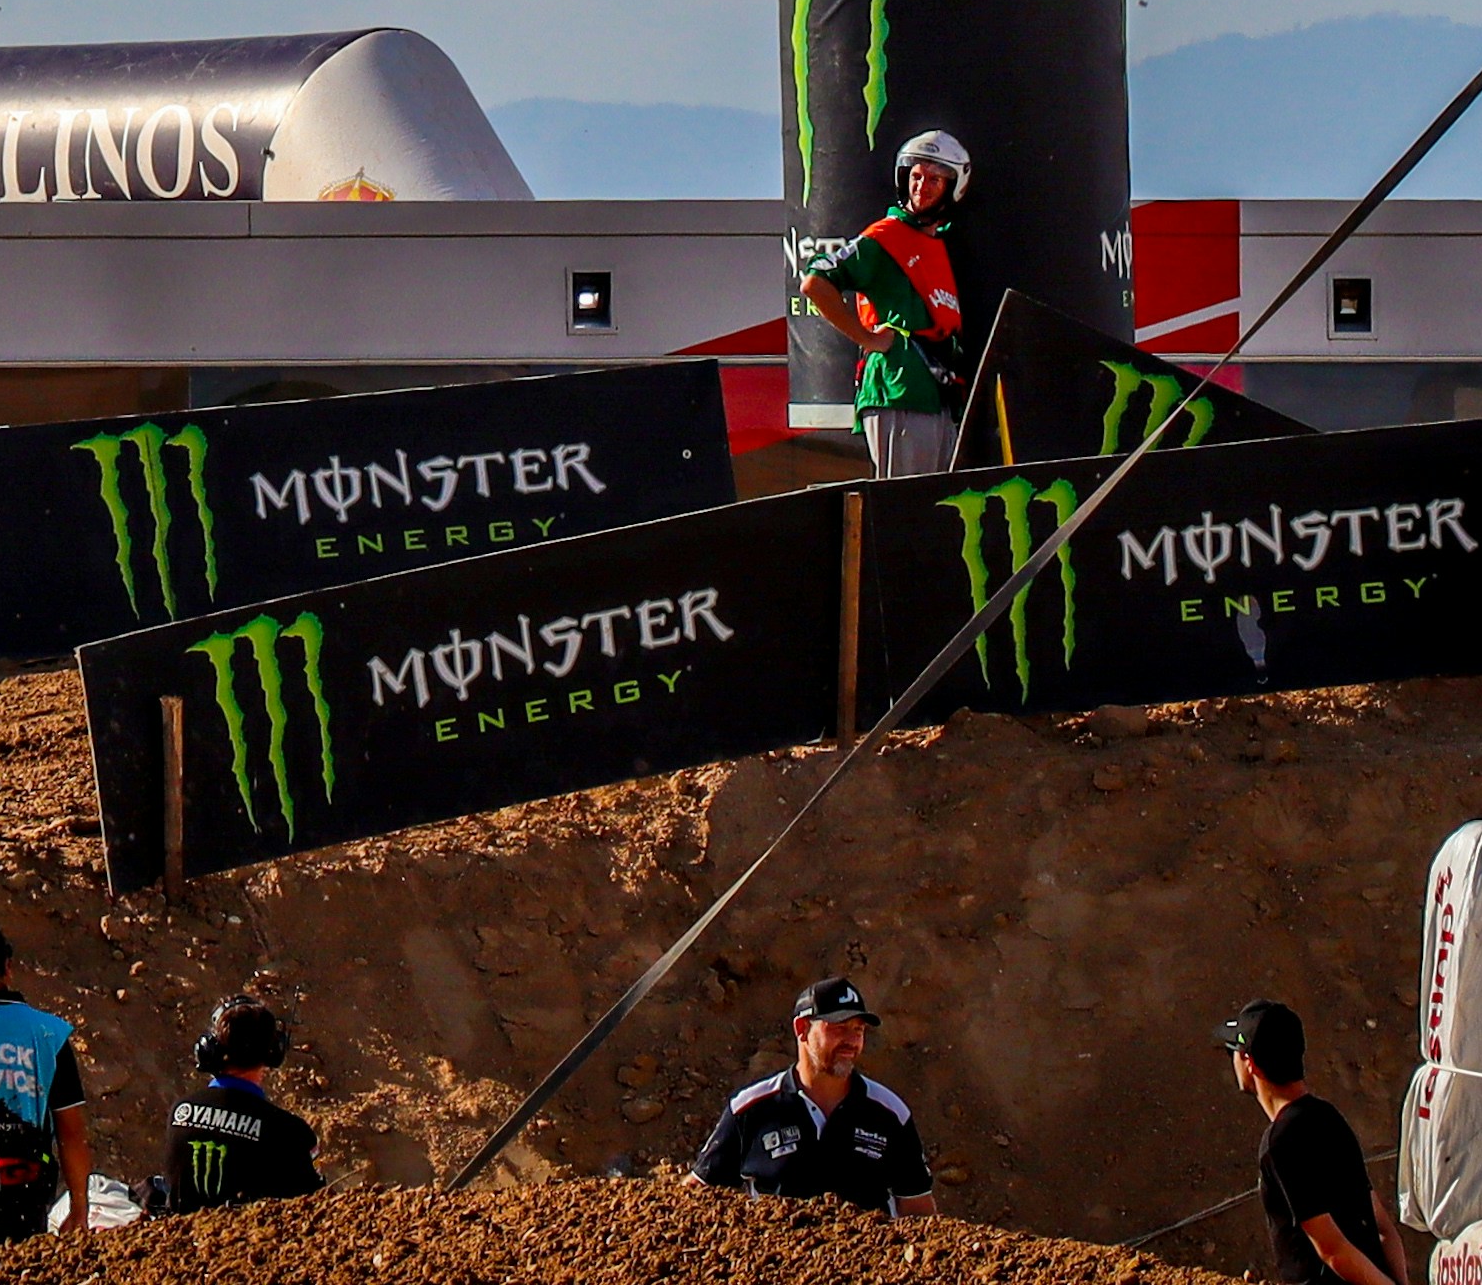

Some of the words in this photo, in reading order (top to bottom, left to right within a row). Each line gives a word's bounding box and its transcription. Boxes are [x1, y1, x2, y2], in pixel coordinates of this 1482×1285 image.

[249, 442, 607, 525] MONSTER
[315, 516, 555, 559] ENERGY
[1117, 497, 1479, 586] MONSTER
[1180, 577, 1427, 621] ENERGY
[366, 586, 735, 709] MONSTER
[435, 669, 683, 742] ENERGY
[192, 1105, 261, 1137] YAMAHA
